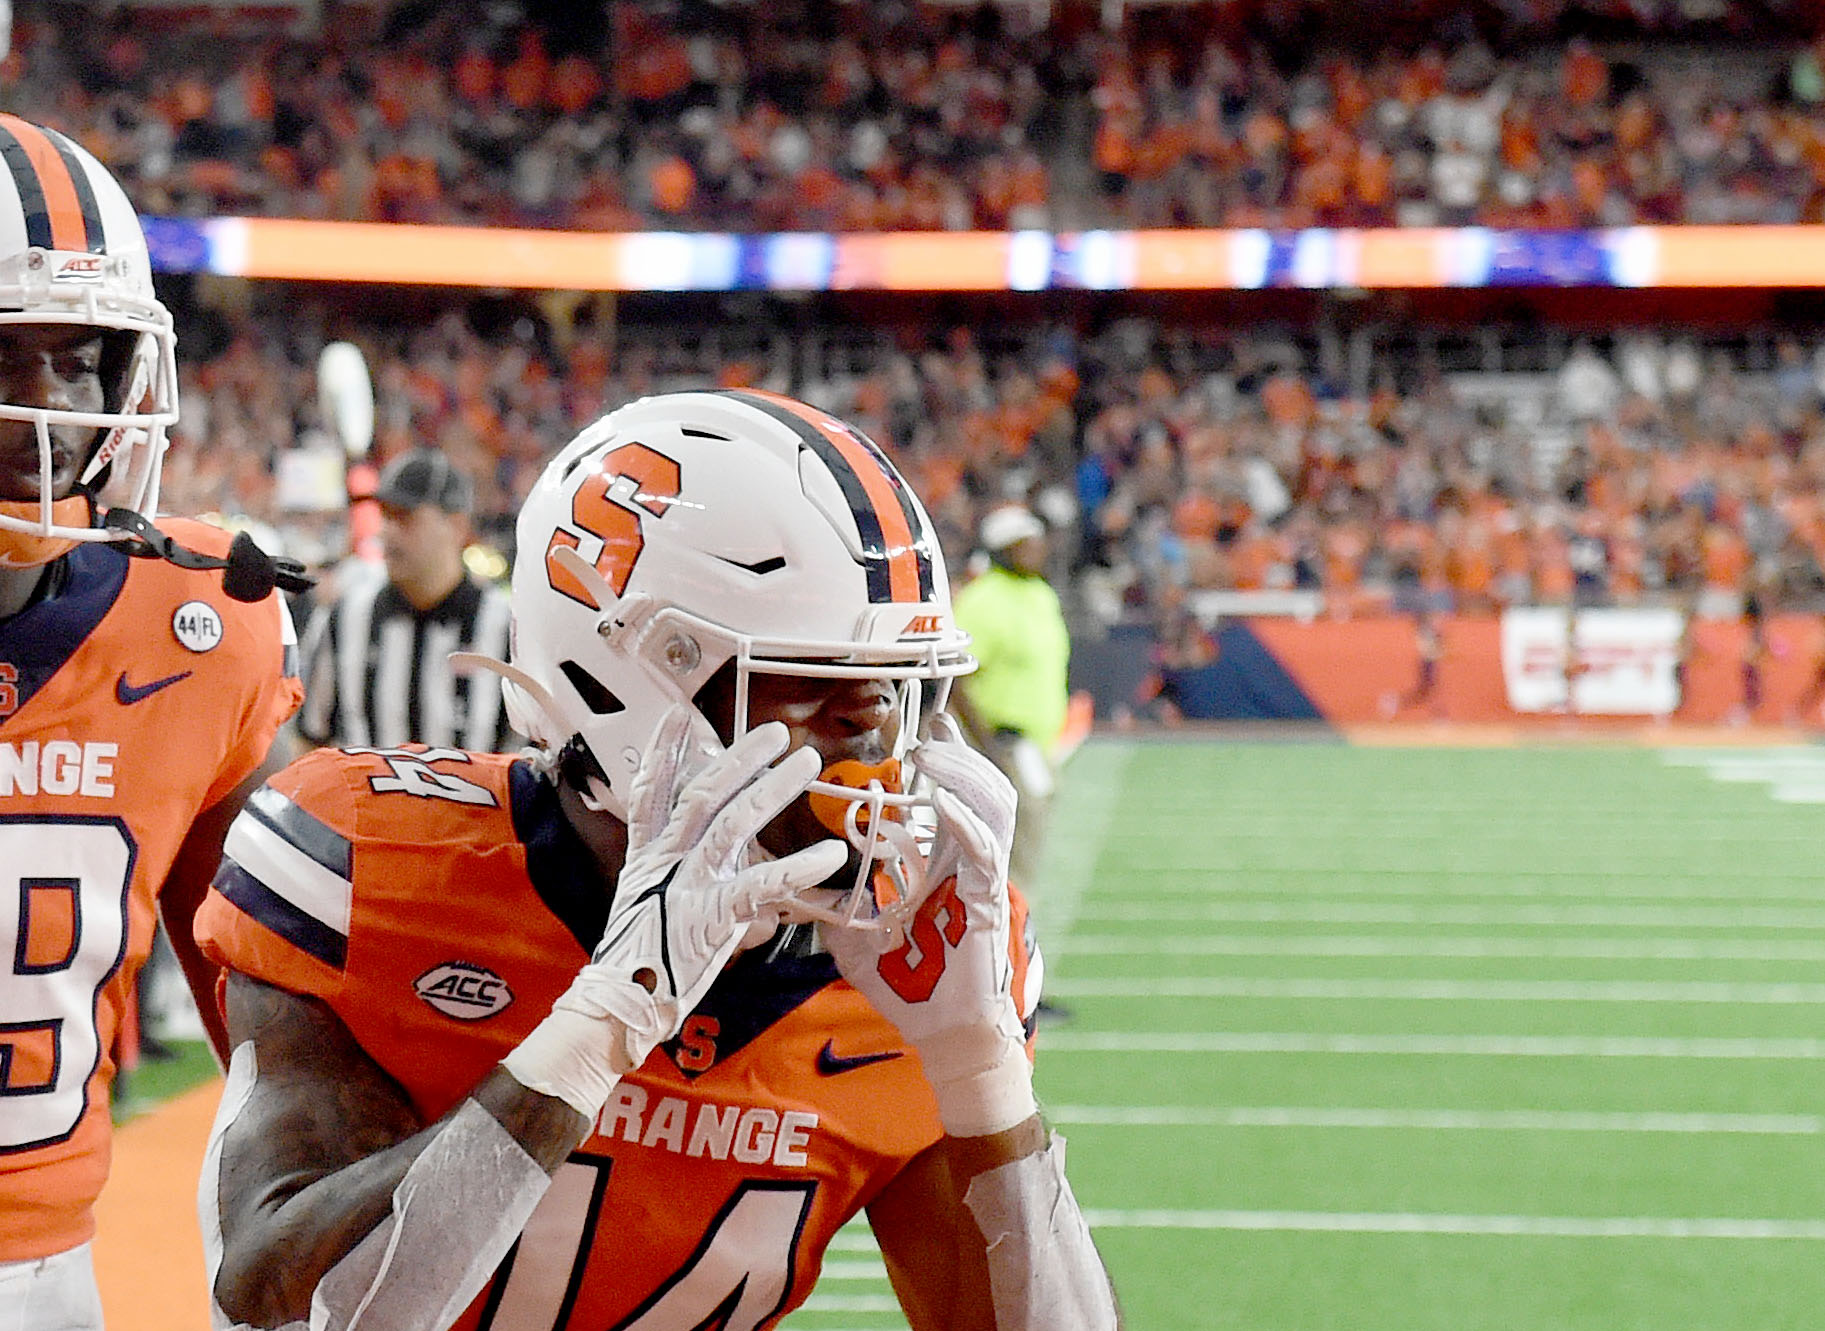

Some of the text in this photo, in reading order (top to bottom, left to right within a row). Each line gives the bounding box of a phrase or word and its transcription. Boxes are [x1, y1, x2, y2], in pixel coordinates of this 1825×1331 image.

[545, 441, 682, 612] S
[876, 873, 968, 1004] S
[426, 975, 504, 1003] ACC
[676, 1013, 722, 1073] S
[592, 1081, 819, 1168] RANGE
